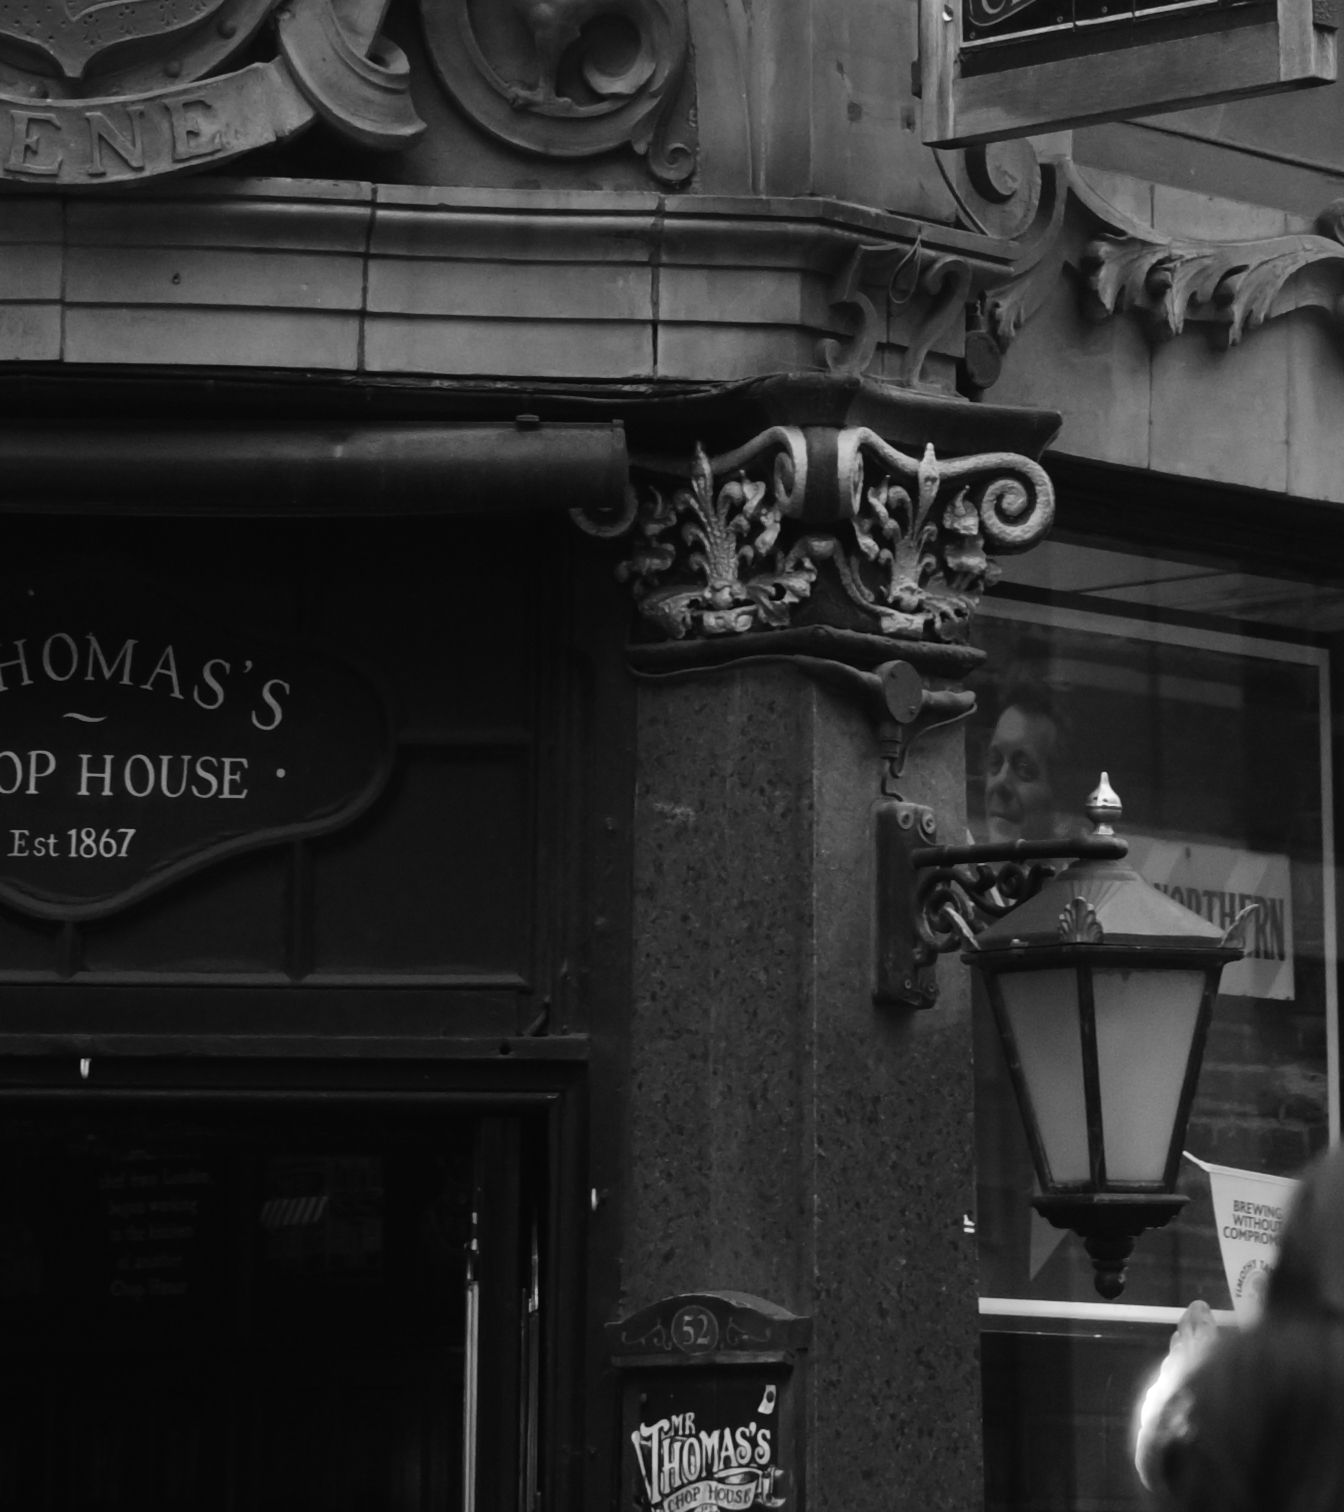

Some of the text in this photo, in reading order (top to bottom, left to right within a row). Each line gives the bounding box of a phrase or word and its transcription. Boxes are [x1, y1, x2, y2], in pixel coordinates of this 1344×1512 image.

[77, 754, 249, 799] HOUSE
[7, 827, 136, 859] Est 1867
[1233, 1200, 1283, 1219] BREWING
[1233, 1214, 1283, 1232] WITHOUT
[682, 1314, 711, 1344] 52
[671, 1412, 695, 1435] MR
[640, 1419, 771, 1504] THOMAS'S
[668, 1484, 752, 1512] CHOP HOUSE
